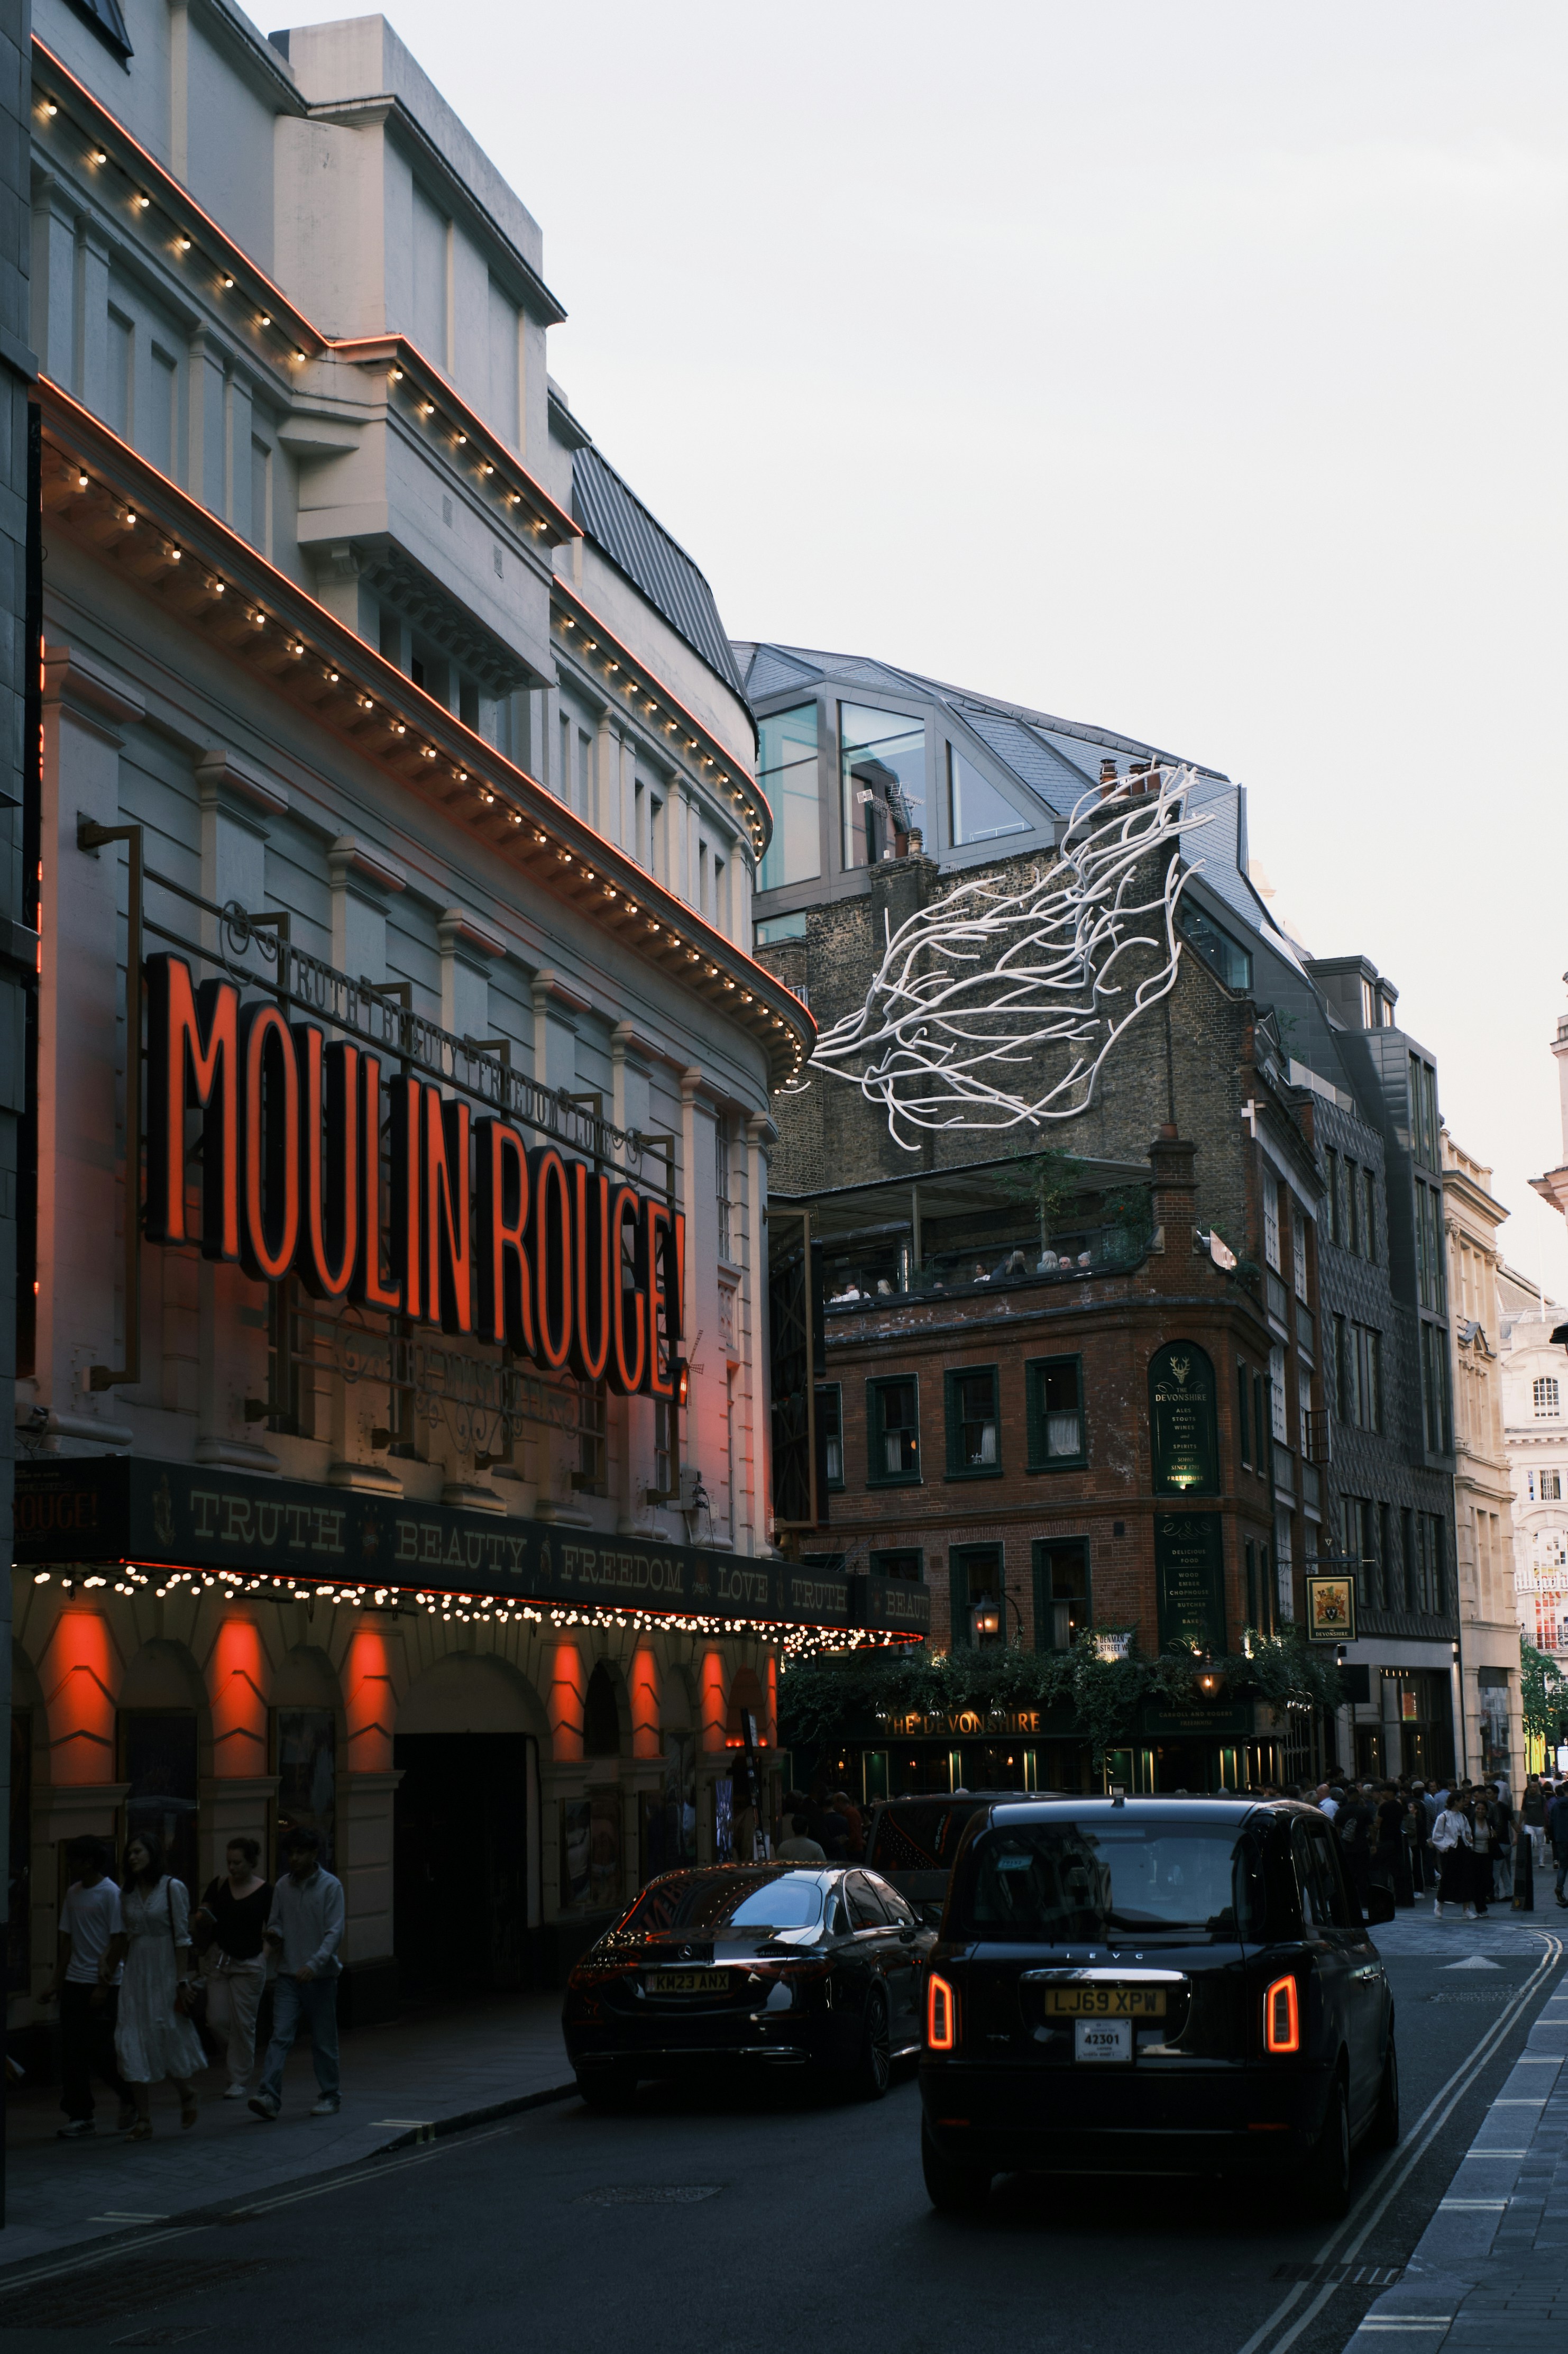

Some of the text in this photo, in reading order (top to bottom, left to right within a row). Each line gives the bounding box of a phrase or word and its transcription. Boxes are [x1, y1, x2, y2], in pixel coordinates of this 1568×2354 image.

[278, 941, 613, 1161] TRUTH BEAUTY FREEDOM LOVE
[145, 951, 686, 1403] MOULIN ROUGE!
[1156, 1393, 1207, 1402] DEVONSHIRE
[190, 1490, 346, 1554] TRUTH
[394, 1519, 528, 1574] BEAUTY
[560, 1544, 684, 1594] FREEDOM
[717, 1566, 768, 1603] LOVE
[791, 1579, 848, 1612] TRUTH
[1100, 1635, 1125, 1644] DENMAN
[883, 1712, 1042, 1735] THE DEVONSHIRE
[656, 1974, 727, 1990] KM23 ANX
[1054, 1992, 1157, 2012] LJ69 XPW
[1085, 2033, 1120, 2045] 42301
